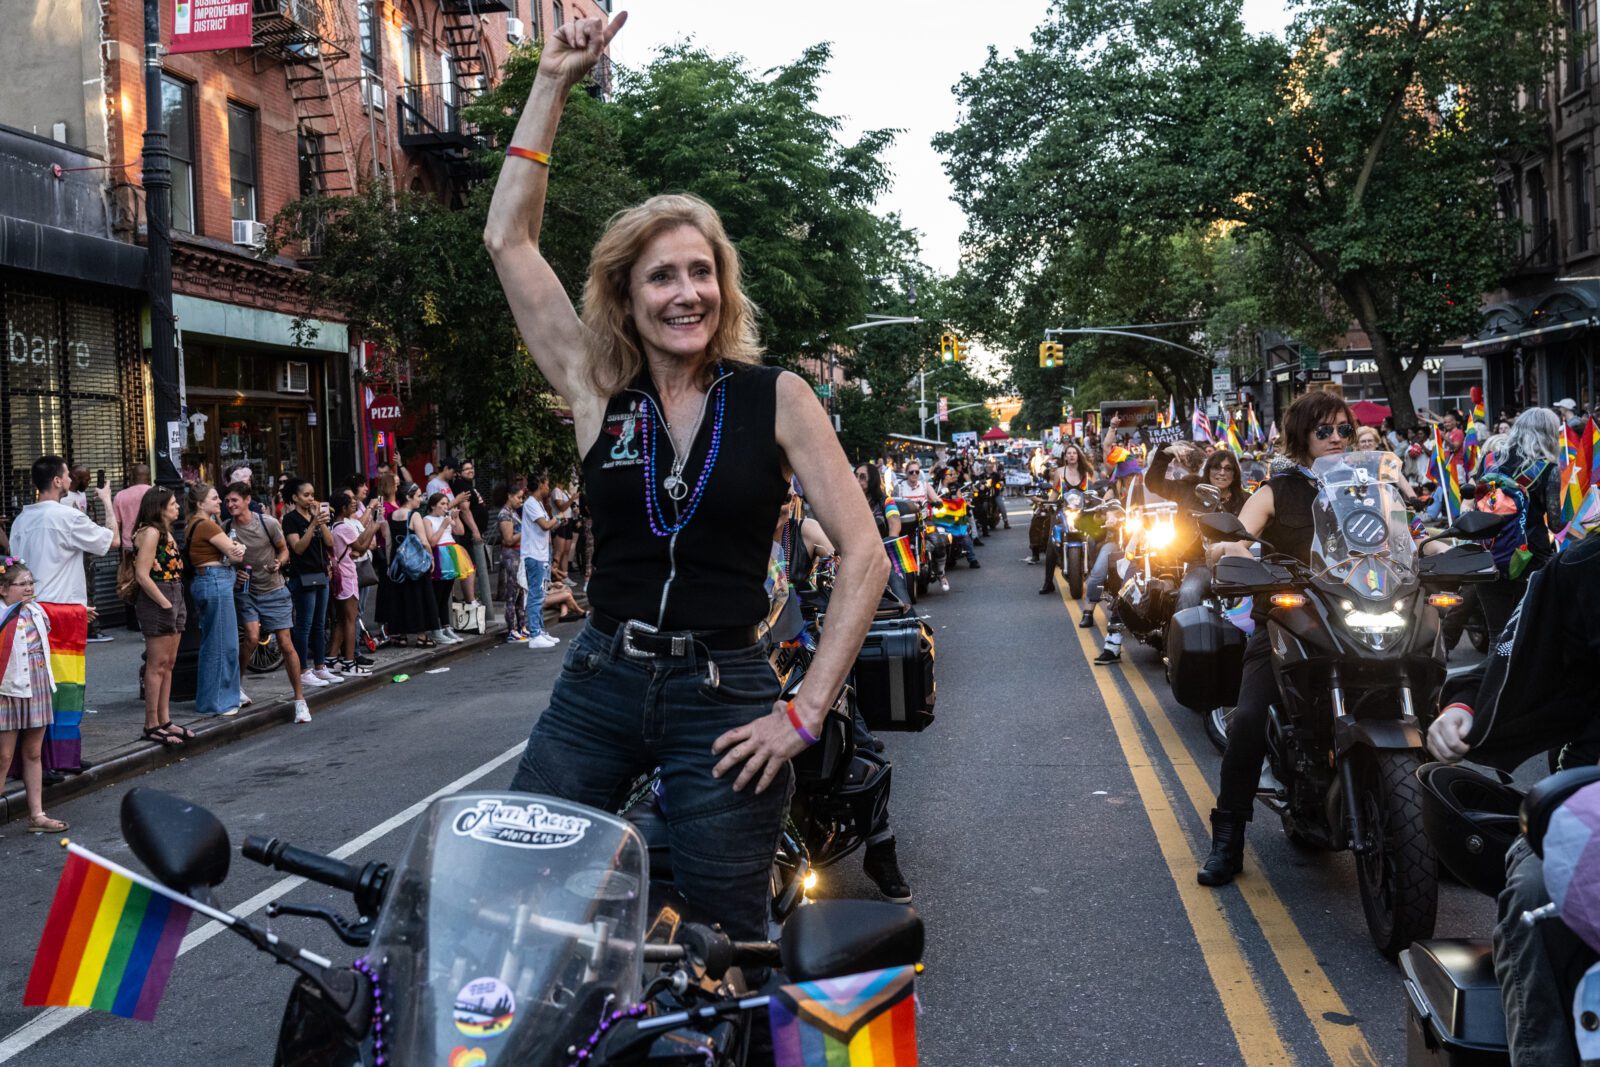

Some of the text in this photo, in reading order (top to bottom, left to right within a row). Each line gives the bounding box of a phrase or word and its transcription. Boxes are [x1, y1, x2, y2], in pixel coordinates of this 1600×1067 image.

[194, 3, 249, 20] IMPROVEMENT
[193, 18, 227, 33] DISTRICT
[1346, 359, 1379, 374] Las
[371, 405, 401, 419] PIZZA
[1101, 411, 1155, 423] naonalgrid
[1147, 425, 1182, 437] TRANS
[1149, 430, 1185, 444] RIGHTS
